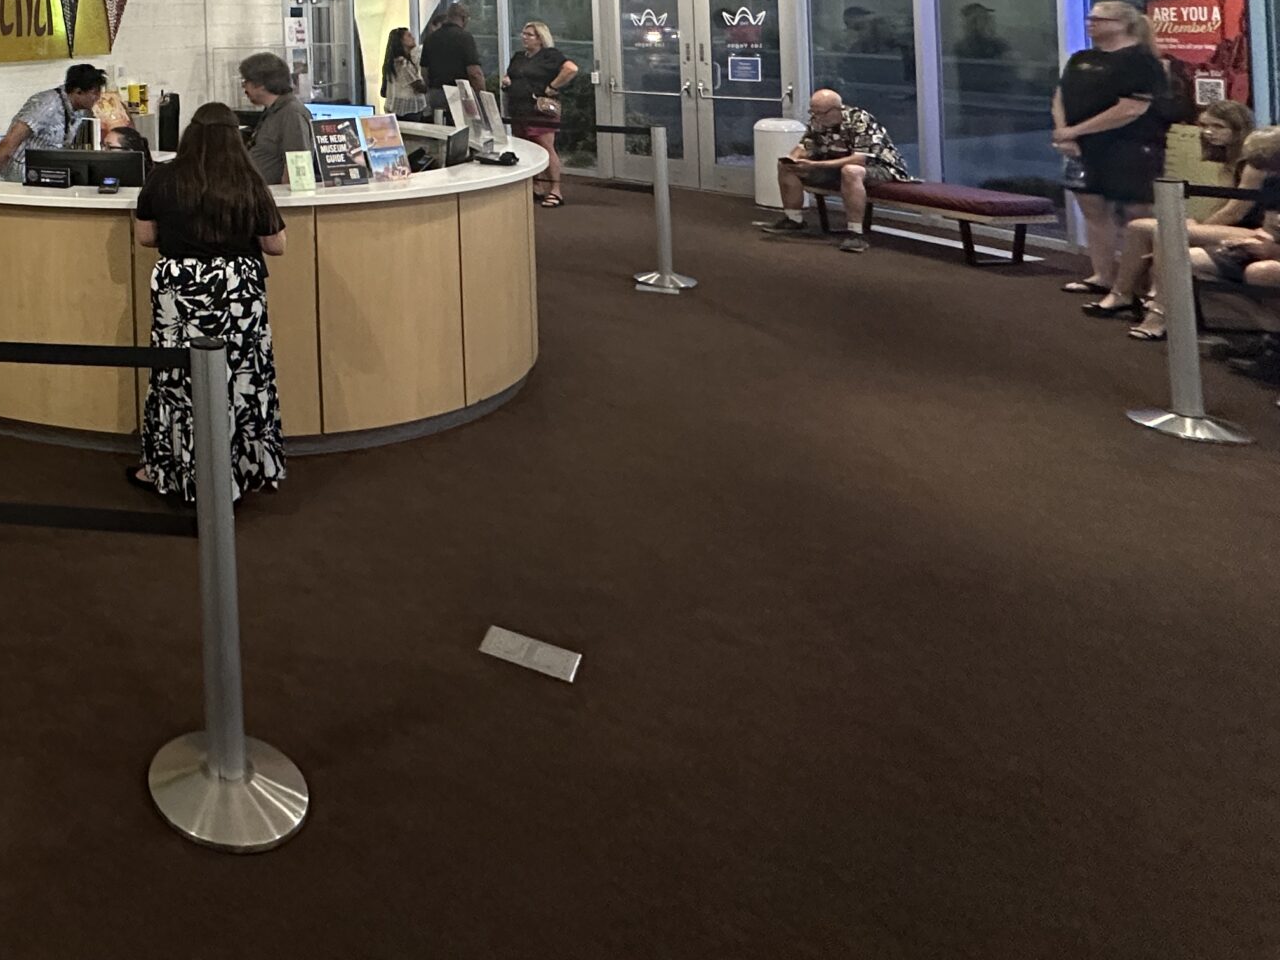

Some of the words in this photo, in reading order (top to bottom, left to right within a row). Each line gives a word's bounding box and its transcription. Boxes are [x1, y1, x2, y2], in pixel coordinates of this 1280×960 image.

[1153, 7, 1178, 21] ARE
[1181, 6, 1208, 22] YOU
[1211, 6, 1221, 21] A
[316, 135, 329, 144] THE
[329, 134, 347, 143] NEON
[320, 143, 347, 154] MUSEUM
[325, 153, 346, 163] GUIDE
